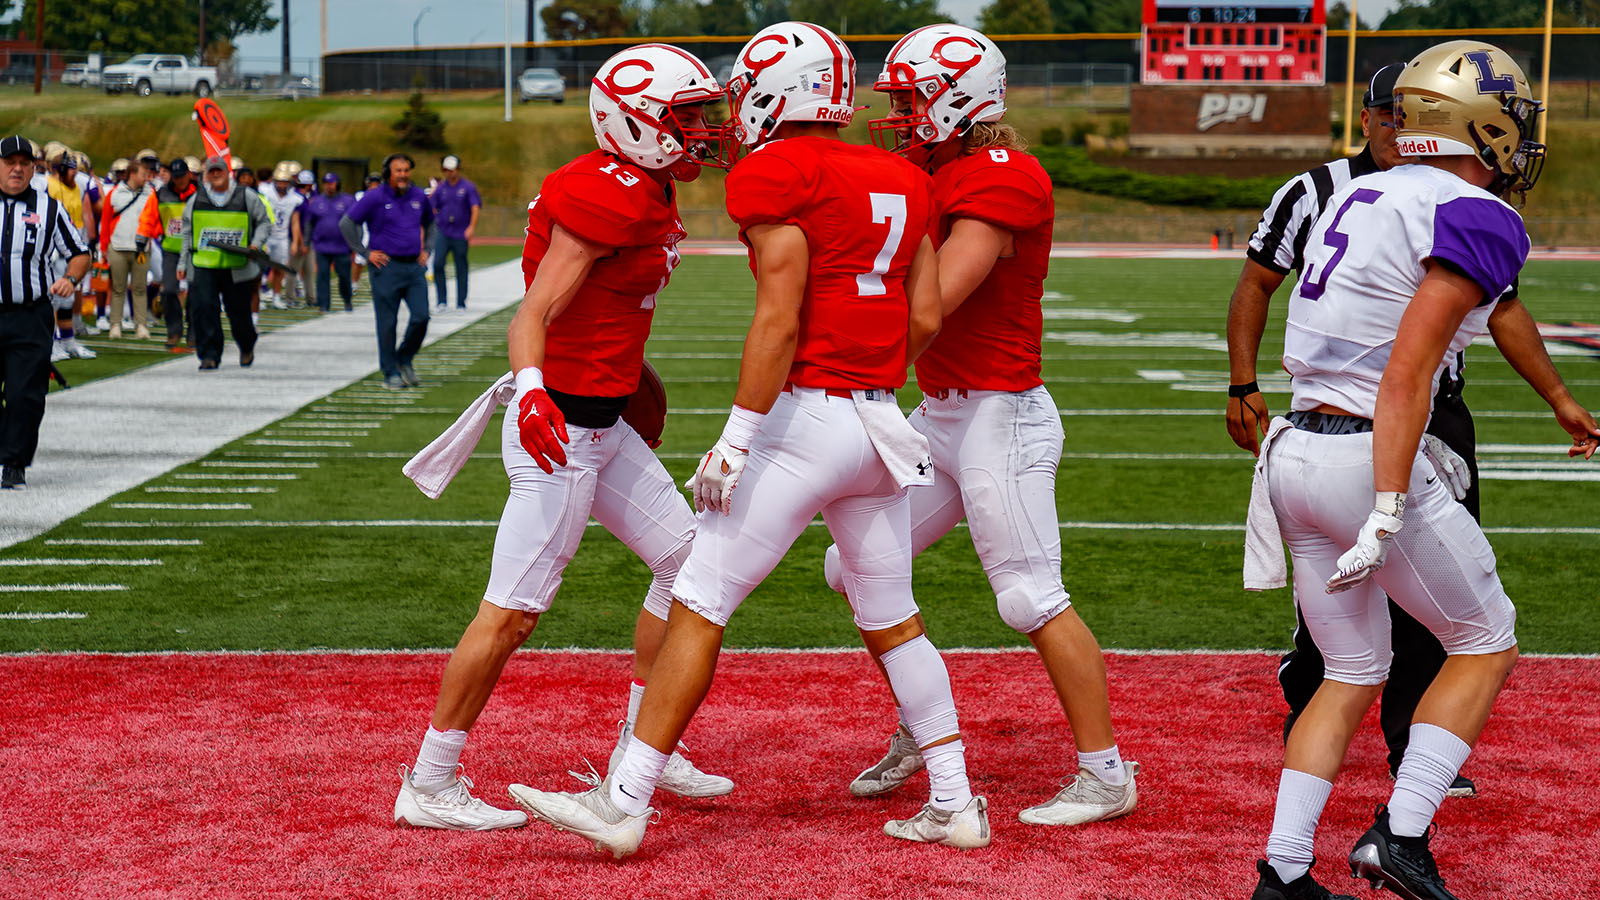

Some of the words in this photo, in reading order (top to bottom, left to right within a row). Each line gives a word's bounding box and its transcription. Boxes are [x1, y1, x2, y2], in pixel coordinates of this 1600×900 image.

[742, 34, 788, 69] C
[929, 36, 982, 69] C
[604, 59, 655, 95] C
[1464, 50, 1517, 95] L
[816, 107, 853, 121] Ridde
[1198, 93, 1267, 131] PPI
[988, 149, 1009, 163] 8
[599, 162, 640, 187] 13
[26, 229, 36, 243] L
[856, 192, 907, 296] 7
[1299, 188, 1383, 300] 5
